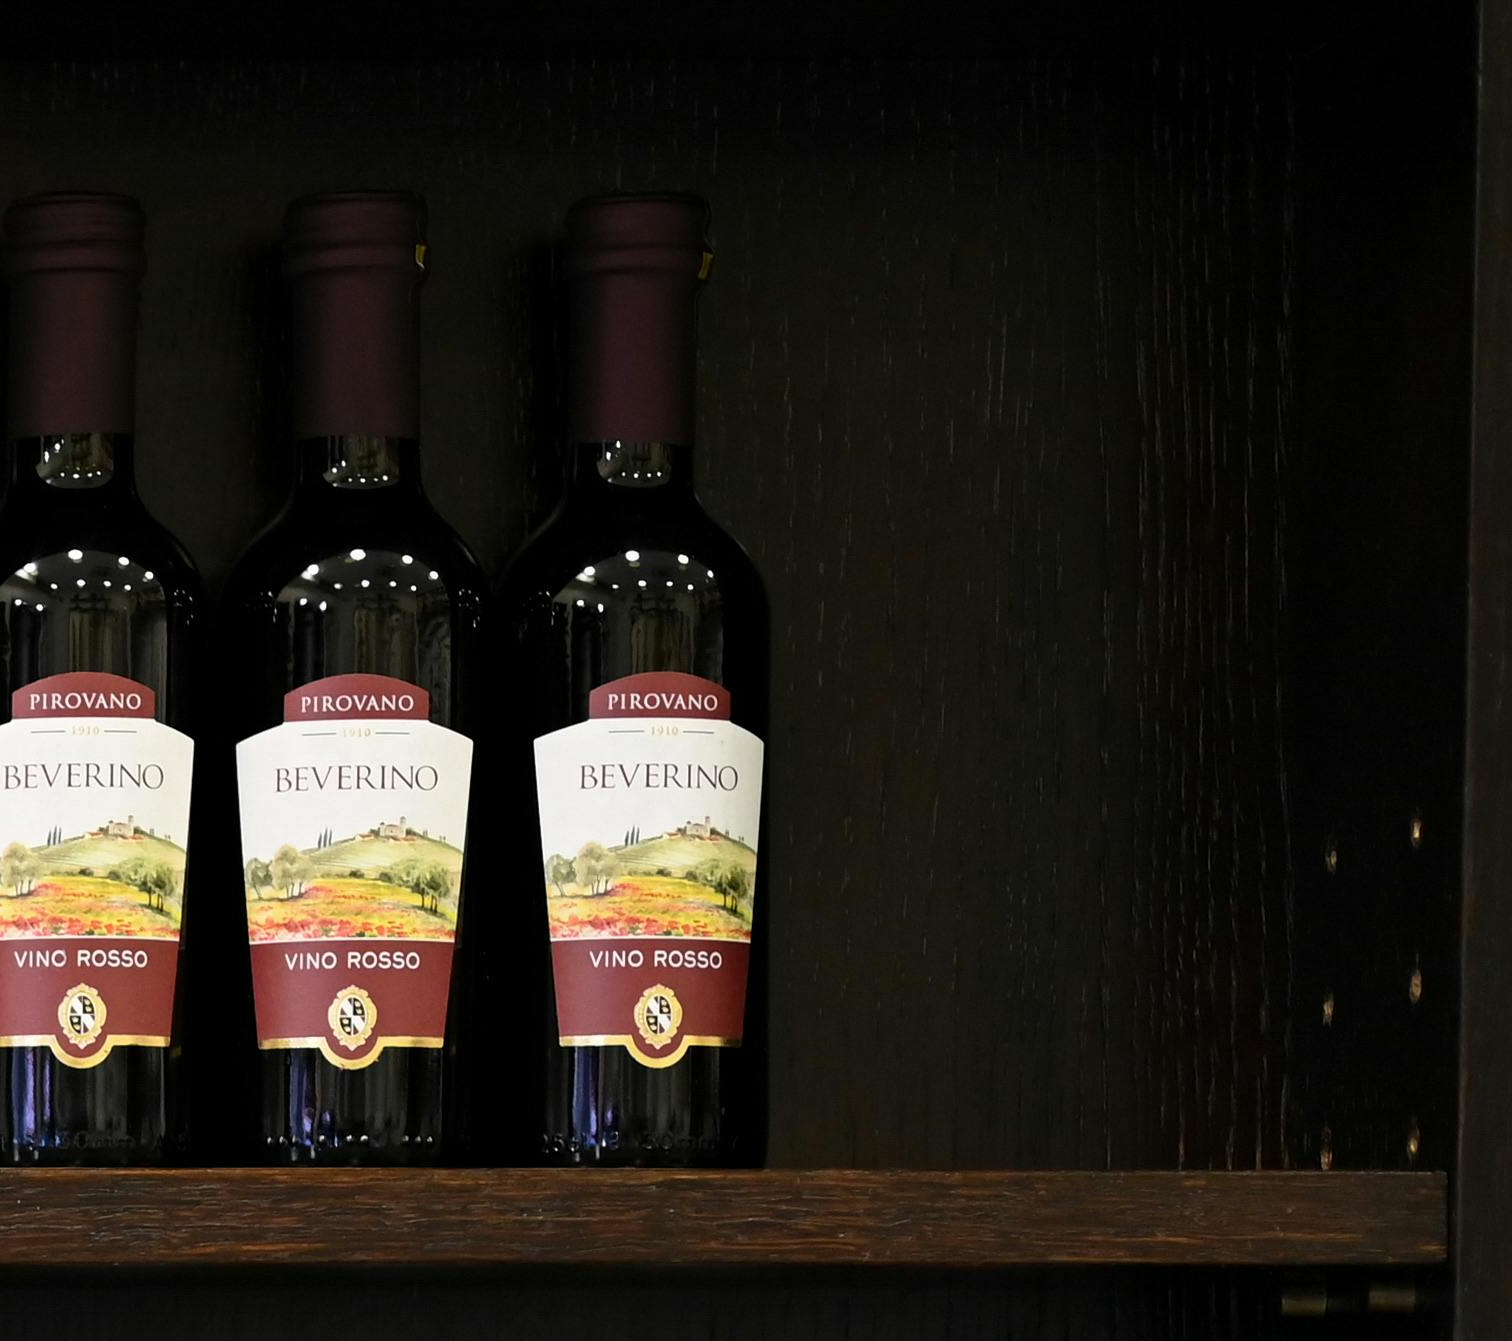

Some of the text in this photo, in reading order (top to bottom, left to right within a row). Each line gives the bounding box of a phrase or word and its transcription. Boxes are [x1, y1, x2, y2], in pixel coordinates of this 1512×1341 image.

[28, 692, 142, 711] PIROVANO
[607, 692, 718, 712] PIROVANO
[650, 726, 680, 737] 1910
[3, 763, 165, 793] BEVERINO
[579, 762, 740, 793] BEVERINO
[14, 949, 149, 969] VINO ROSSO
[589, 950, 723, 969] VINO ROSSO
